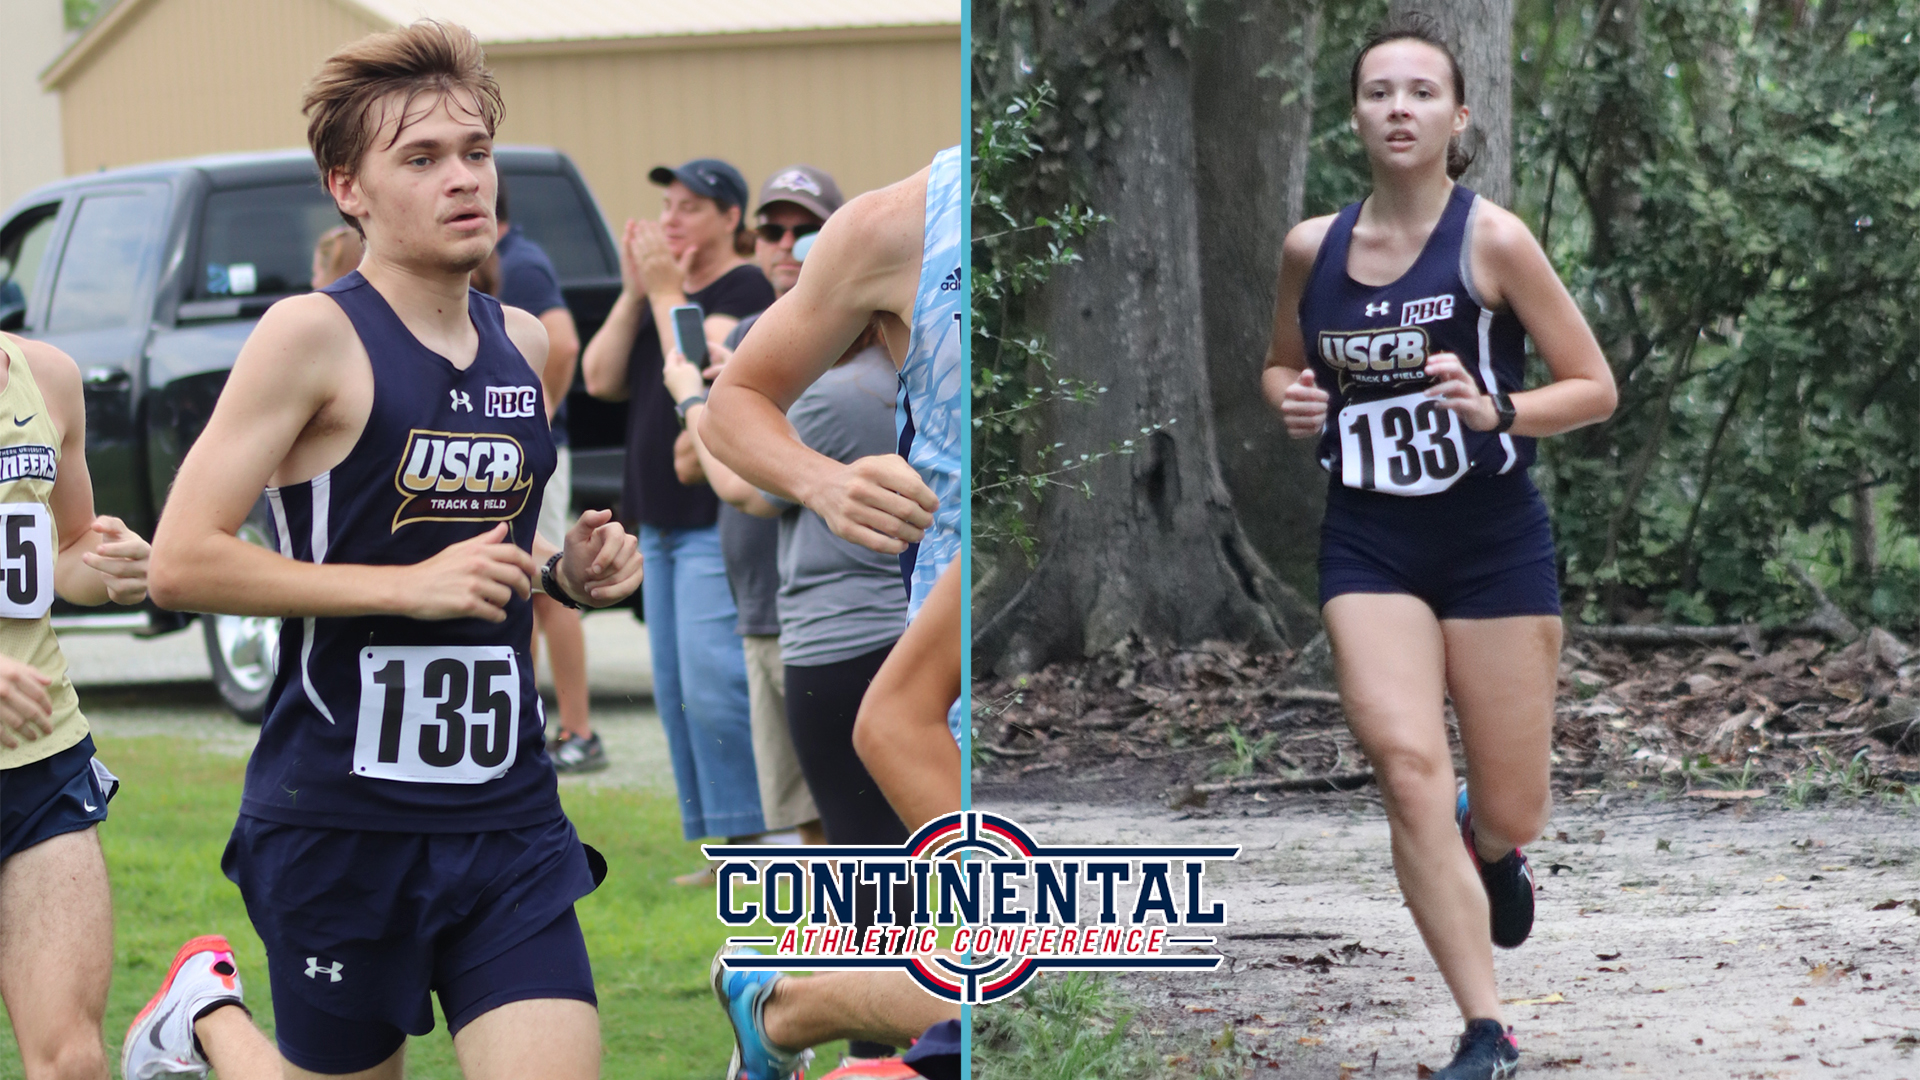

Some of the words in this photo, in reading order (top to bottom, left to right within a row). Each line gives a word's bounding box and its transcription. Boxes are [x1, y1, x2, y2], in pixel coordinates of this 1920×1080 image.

[1401, 294, 1455, 327] PBC
[1322, 331, 1425, 371] USCB
[1351, 374, 1380, 382] TRACK
[1382, 374, 1390, 382] &
[1392, 371, 1424, 380] FIELD
[485, 386, 537, 418] PBC
[1348, 399, 1460, 489] 133
[0, 450, 56, 480] NEERS
[403, 438, 520, 493] USCB
[430, 499, 467, 510] TRACK
[471, 500, 480, 510] &
[483, 499, 507, 510] FIELD
[0, 514, 38, 606] 5
[372, 657, 512, 769] 135
